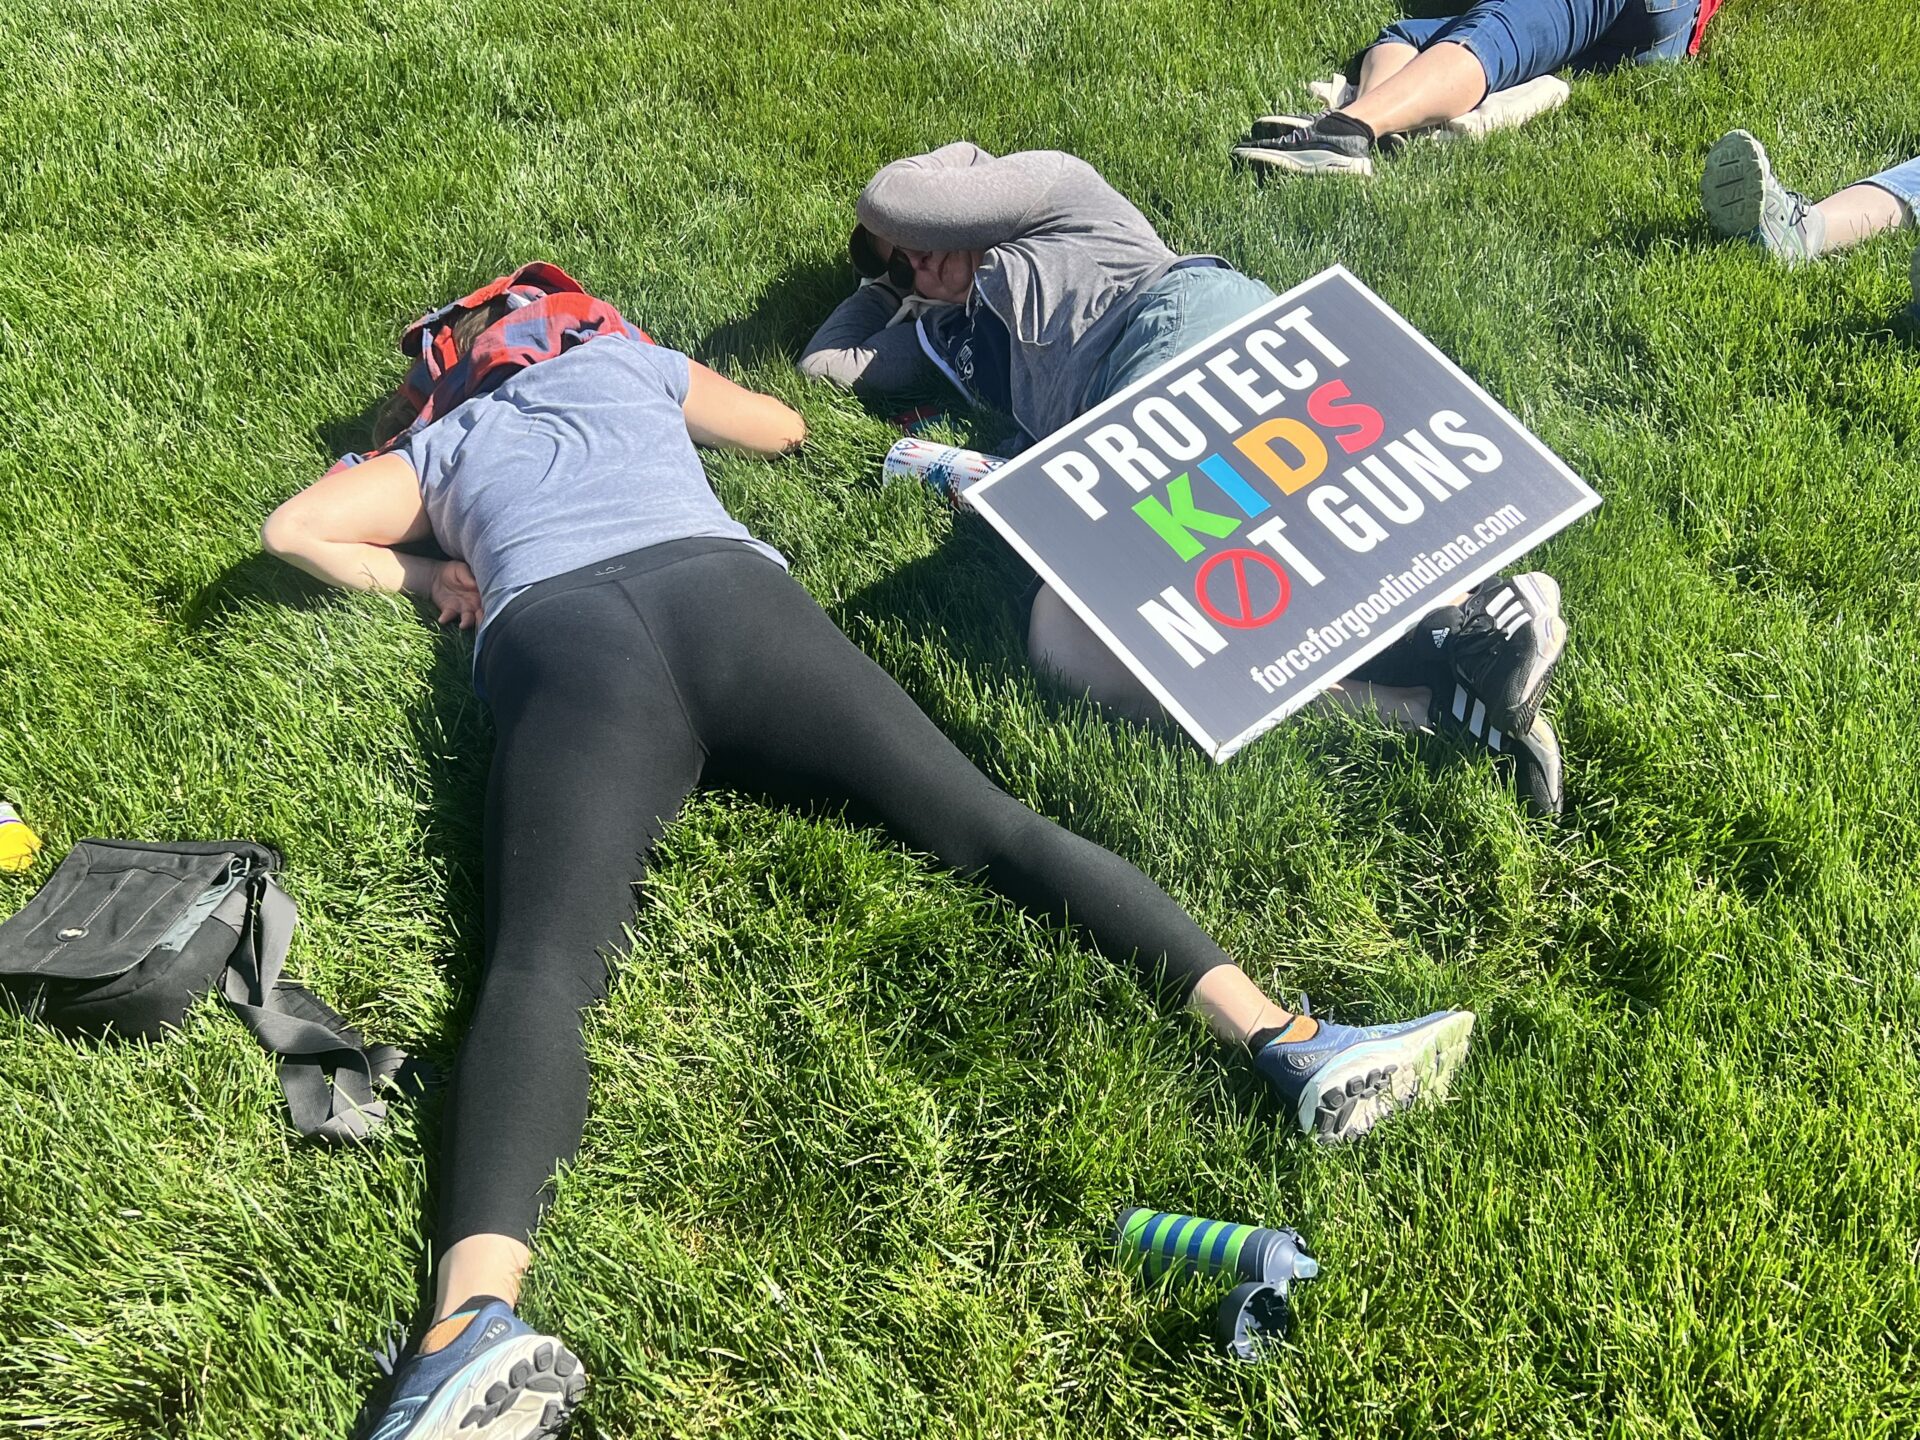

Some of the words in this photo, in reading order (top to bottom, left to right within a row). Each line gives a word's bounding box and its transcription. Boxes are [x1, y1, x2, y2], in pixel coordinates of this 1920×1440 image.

[1041, 305, 1350, 521] PROTECT
[1132, 380, 1385, 562] KIDS
[1306, 410, 1503, 553] GUNS
[1250, 503, 1527, 694] forceforgoodindiana.com
